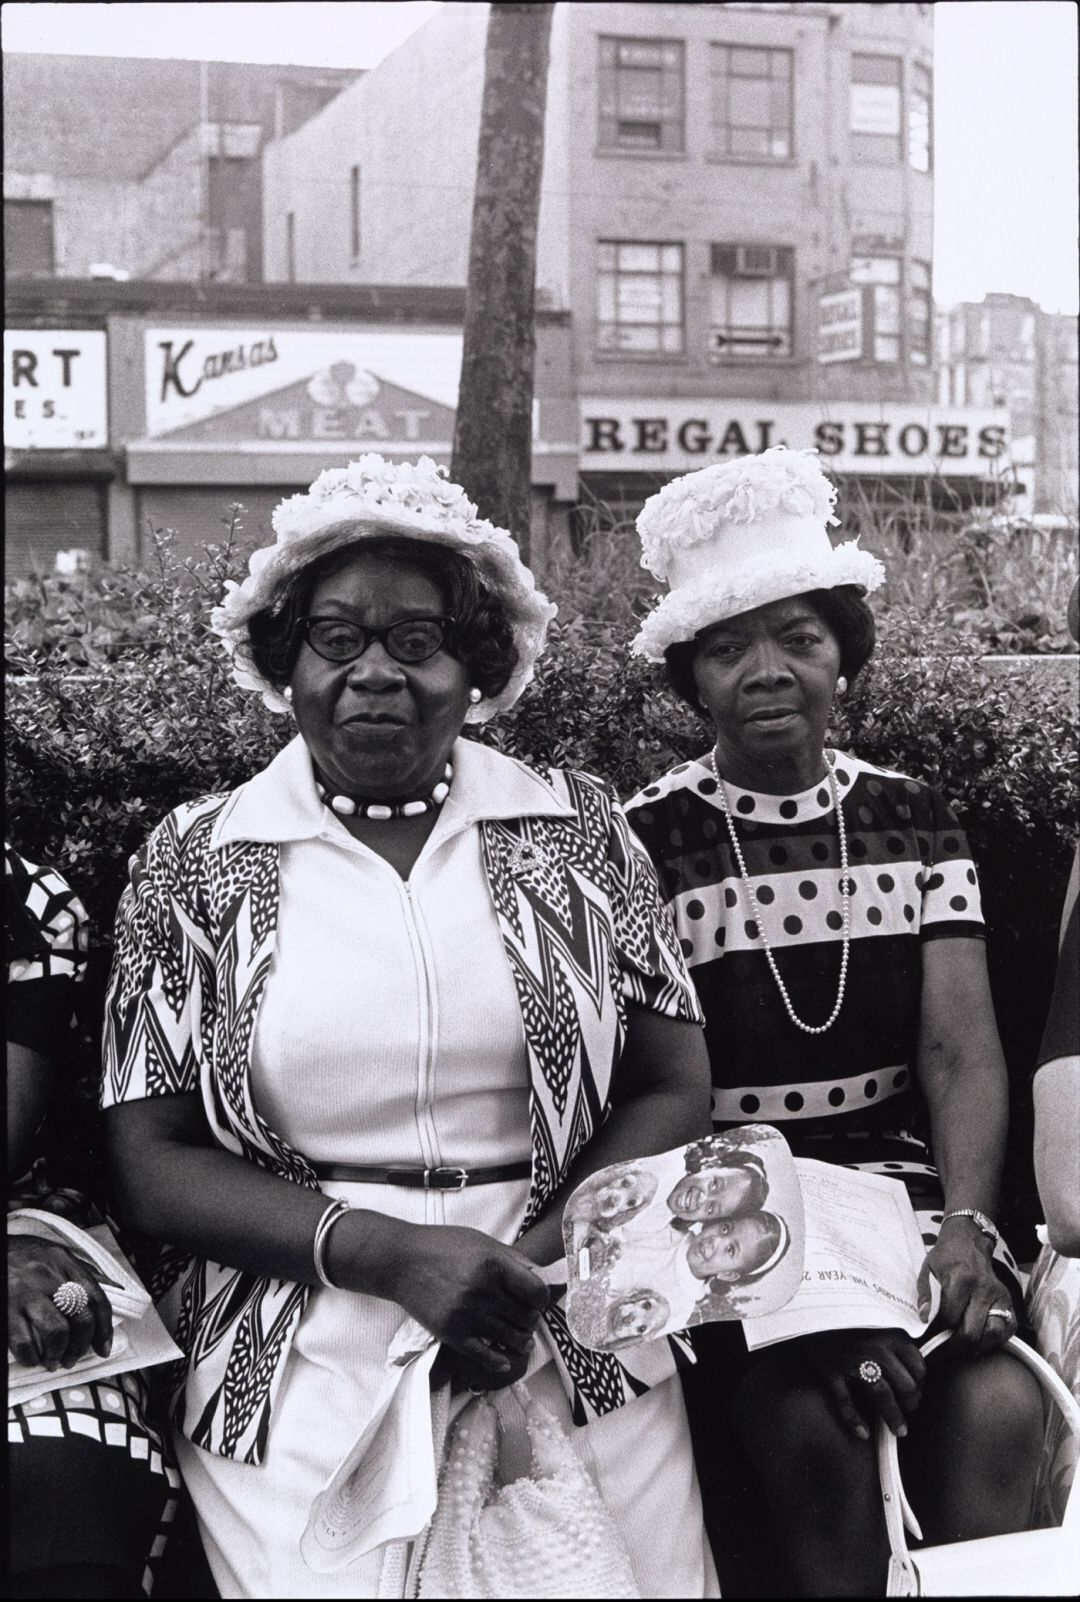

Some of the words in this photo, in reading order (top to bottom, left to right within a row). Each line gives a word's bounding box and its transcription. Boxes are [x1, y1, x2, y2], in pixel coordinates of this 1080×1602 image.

[13, 349, 80, 387] RT
[158, 336, 279, 402] Kansas
[257, 408, 430, 439] MEAT
[586, 418, 786, 453] REGAL
[816, 423, 1005, 458] SHOES
[819, 1272, 848, 1281] YEAR
